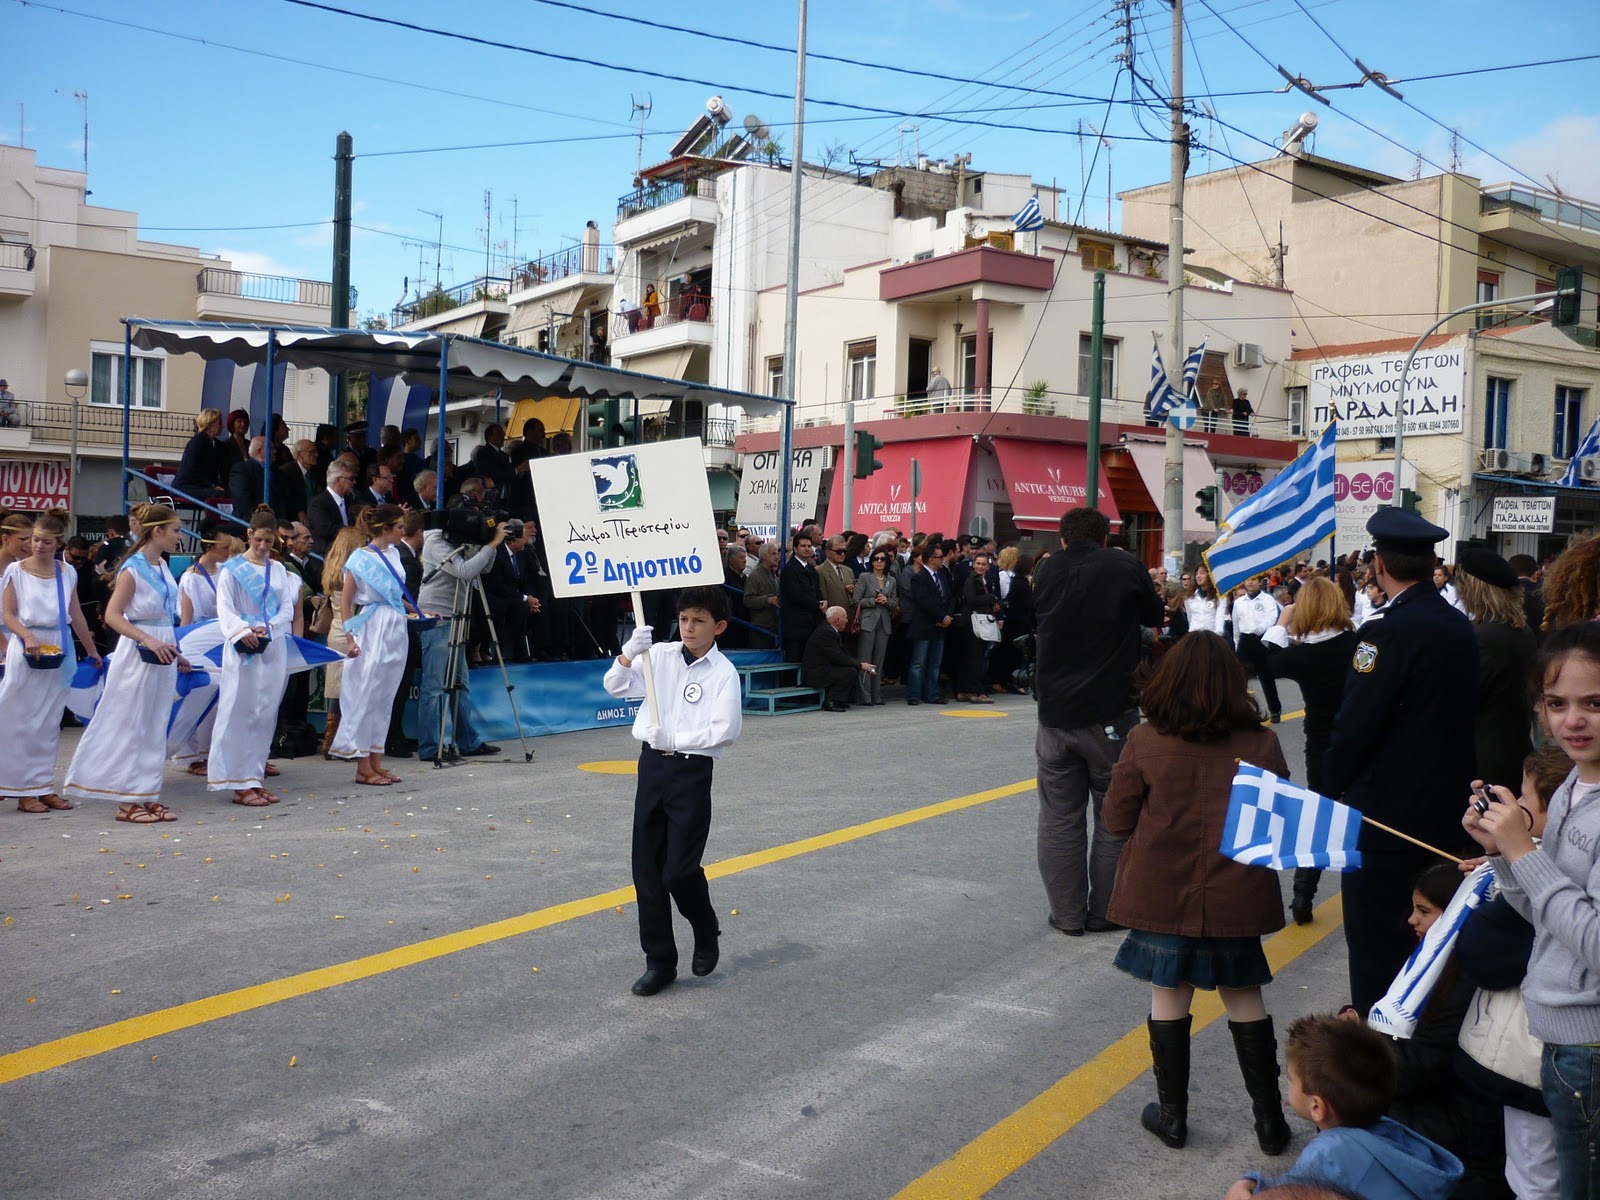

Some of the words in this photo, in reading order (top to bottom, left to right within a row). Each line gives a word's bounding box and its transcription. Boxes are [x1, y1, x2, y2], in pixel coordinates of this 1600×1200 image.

[1381, 354, 1459, 374] ΤΕΕΤΩΝ
[753, 450, 812, 470] ΟΠΚΑ
[749, 477, 809, 495] ΧΑΛΚΗΣ
[1014, 482, 1056, 495] ANTICA
[1056, 485, 1106, 498] MURRA
[857, 503, 887, 515] ANTICA
[888, 501, 927, 514] MURRNA
[1048, 495, 1077, 504] VENEZIA
[879, 514, 901, 523] VENEZIA
[603, 518, 690, 540] Περιστερίου
[603, 547, 703, 587] Δημοτικό
[597, 708, 626, 721] ΔΗΜΟΣ
[628, 706, 641, 717] ΠΕ
